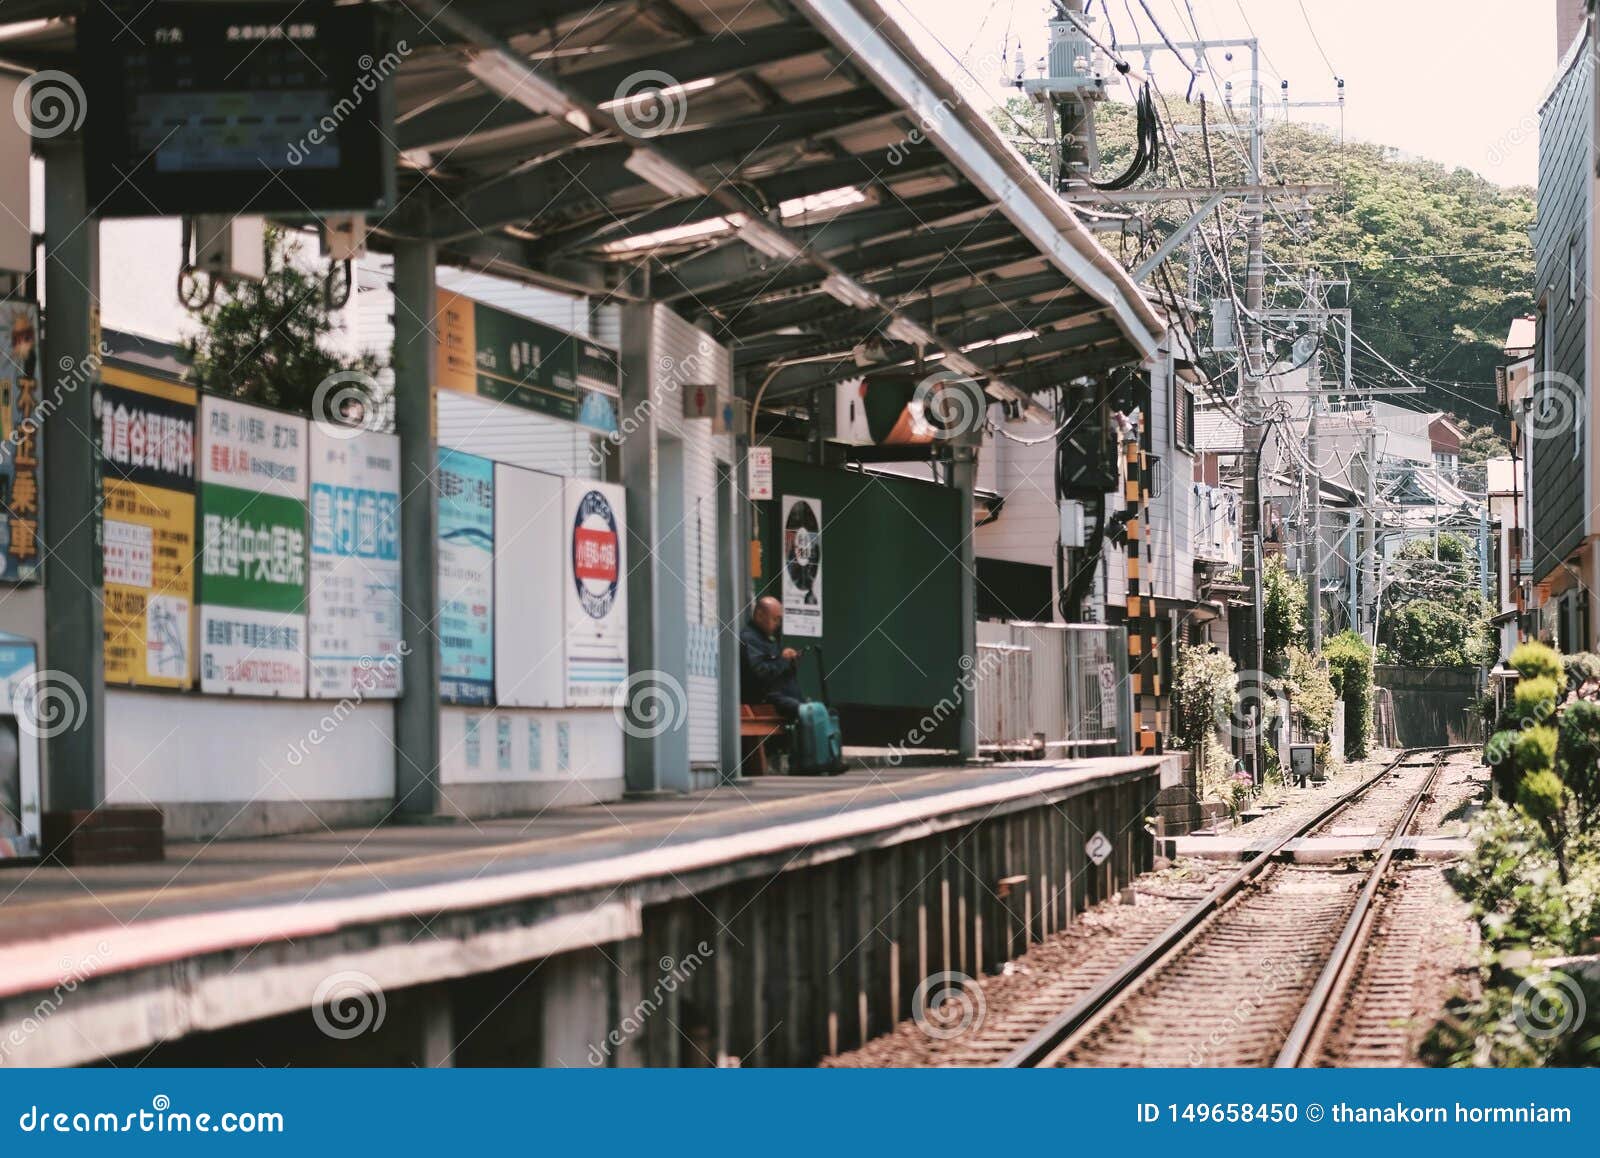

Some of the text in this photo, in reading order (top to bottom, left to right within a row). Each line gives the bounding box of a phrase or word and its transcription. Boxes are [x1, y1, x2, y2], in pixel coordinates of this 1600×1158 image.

[203, 514, 304, 586] 腰越中央医院
[1092, 835, 1104, 858] 2
